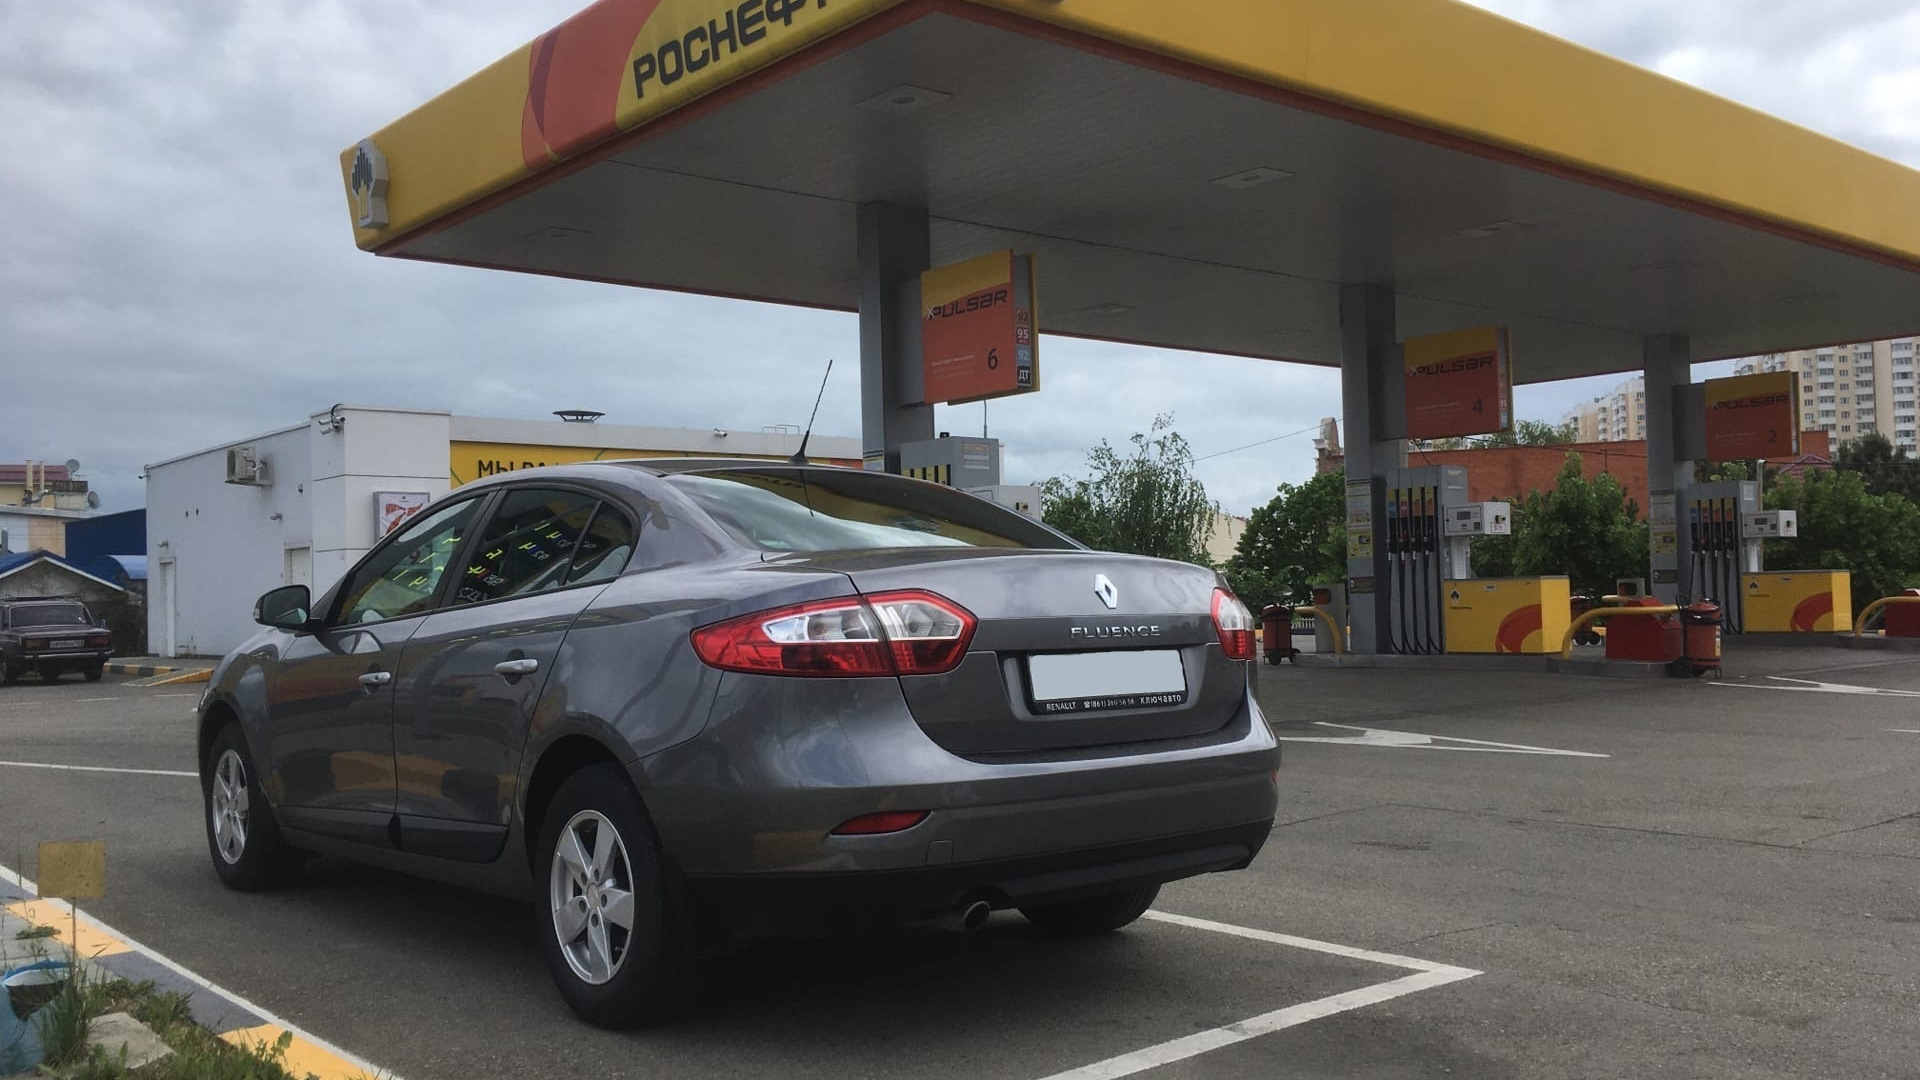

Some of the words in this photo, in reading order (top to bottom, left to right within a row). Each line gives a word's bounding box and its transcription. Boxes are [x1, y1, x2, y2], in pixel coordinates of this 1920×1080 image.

[1016, 327, 1029, 340] 95
[987, 348, 999, 370] 6
[1017, 349, 1029, 361] 92
[1018, 369, 1030, 382] ДТ
[1472, 399, 1484, 413] 4
[1768, 429, 1777, 444] 2
[1070, 625, 1161, 639] FLUENCE
[1046, 701, 1077, 711] RENAULT
